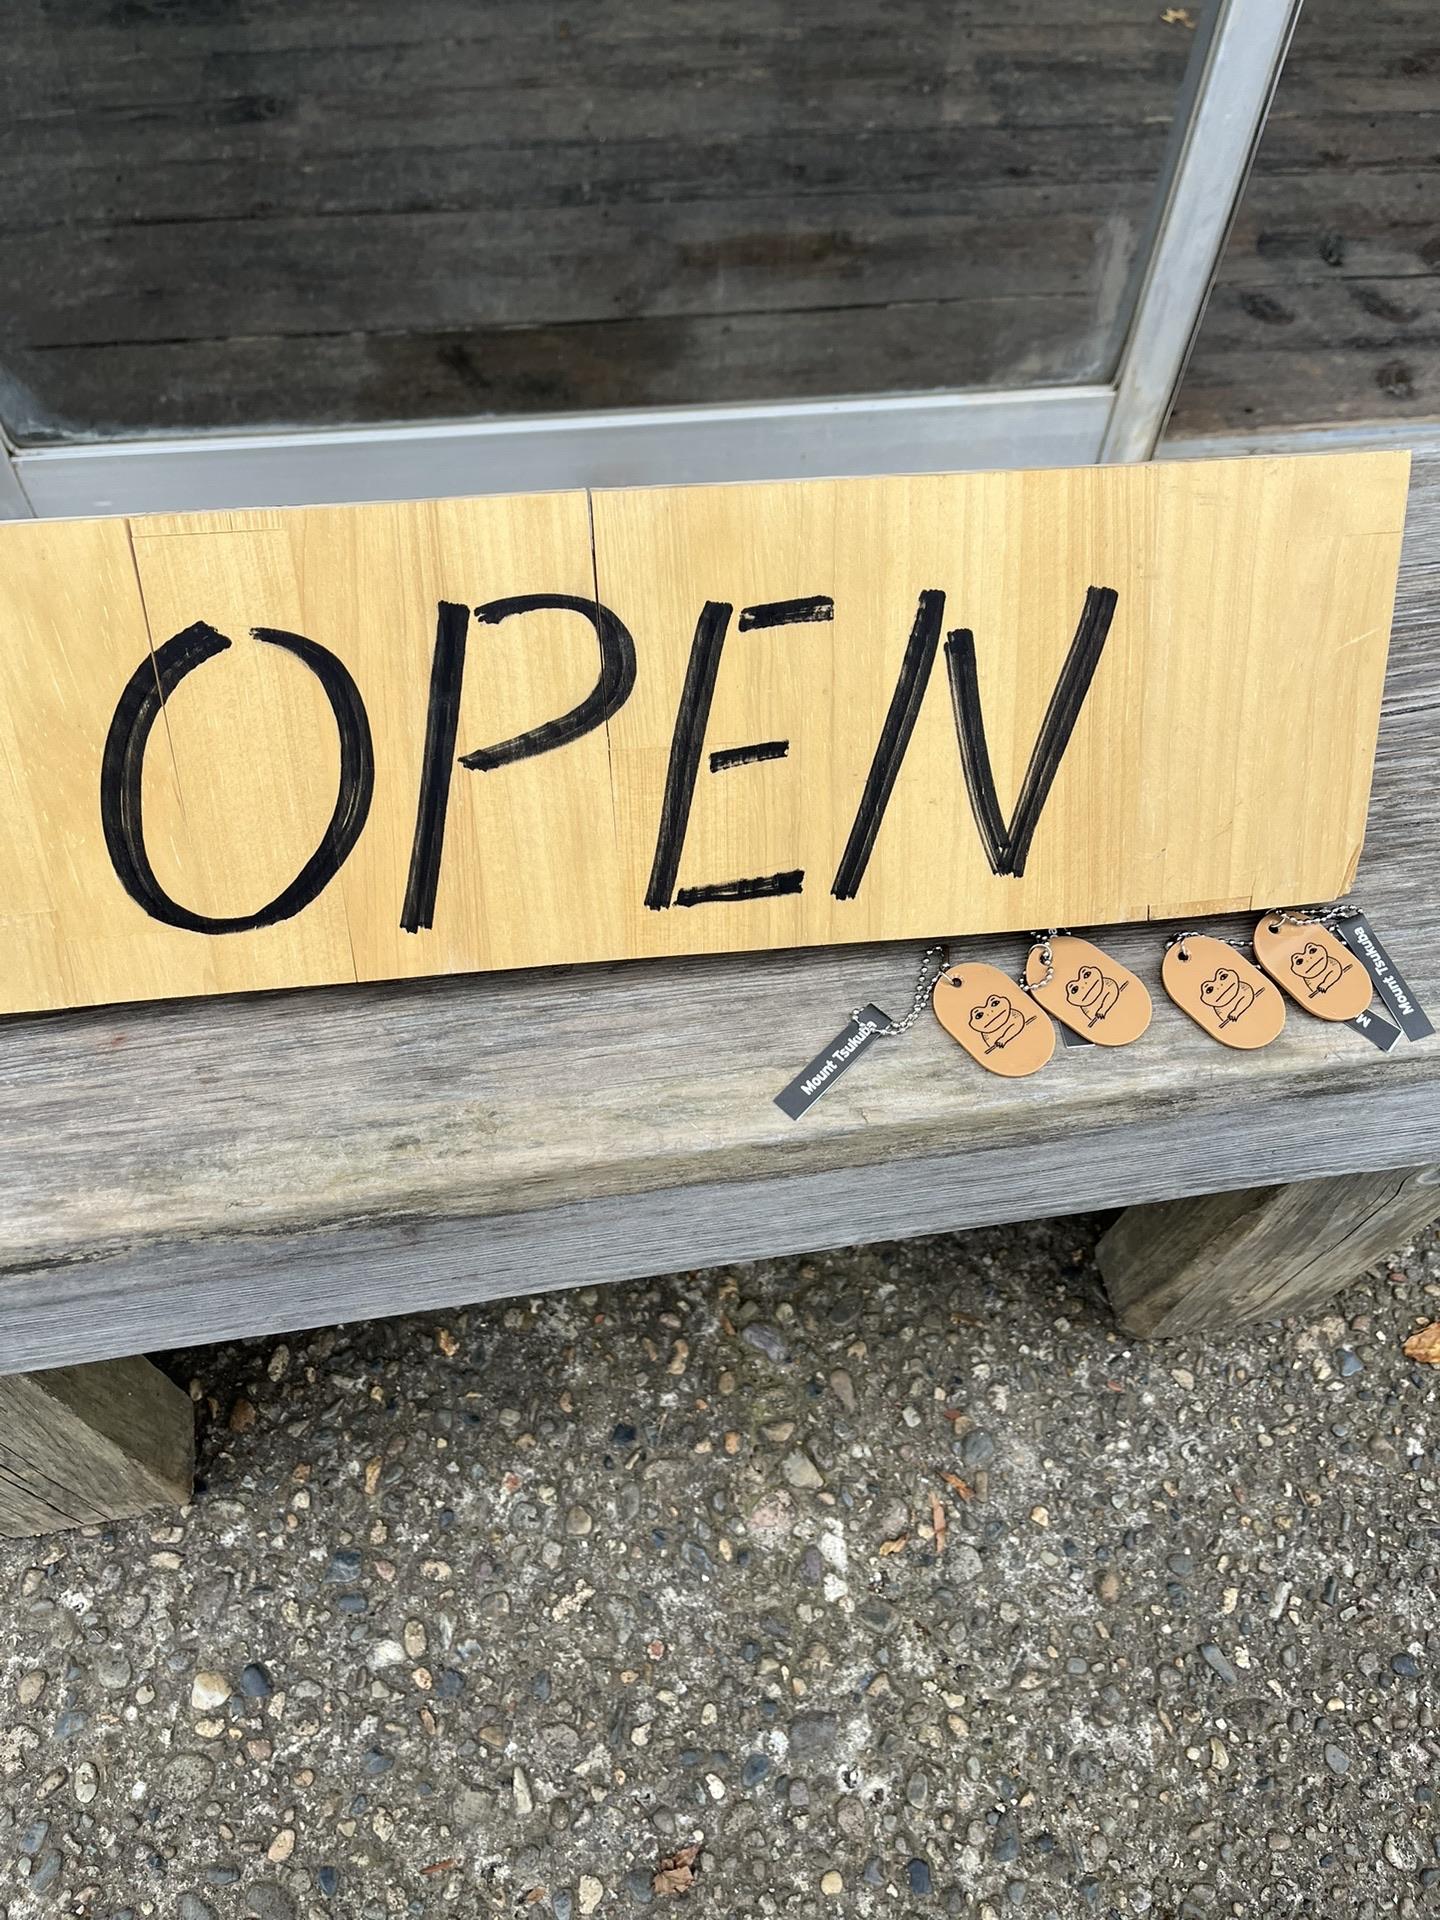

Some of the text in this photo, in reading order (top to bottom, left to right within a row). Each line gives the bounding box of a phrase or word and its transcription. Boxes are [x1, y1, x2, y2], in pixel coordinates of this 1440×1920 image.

[101, 585, 1118, 934] OPEN
[1354, 926, 1414, 1015] Mount Tsukuba
[800, 1021, 878, 1096] Mount Tsukuba
